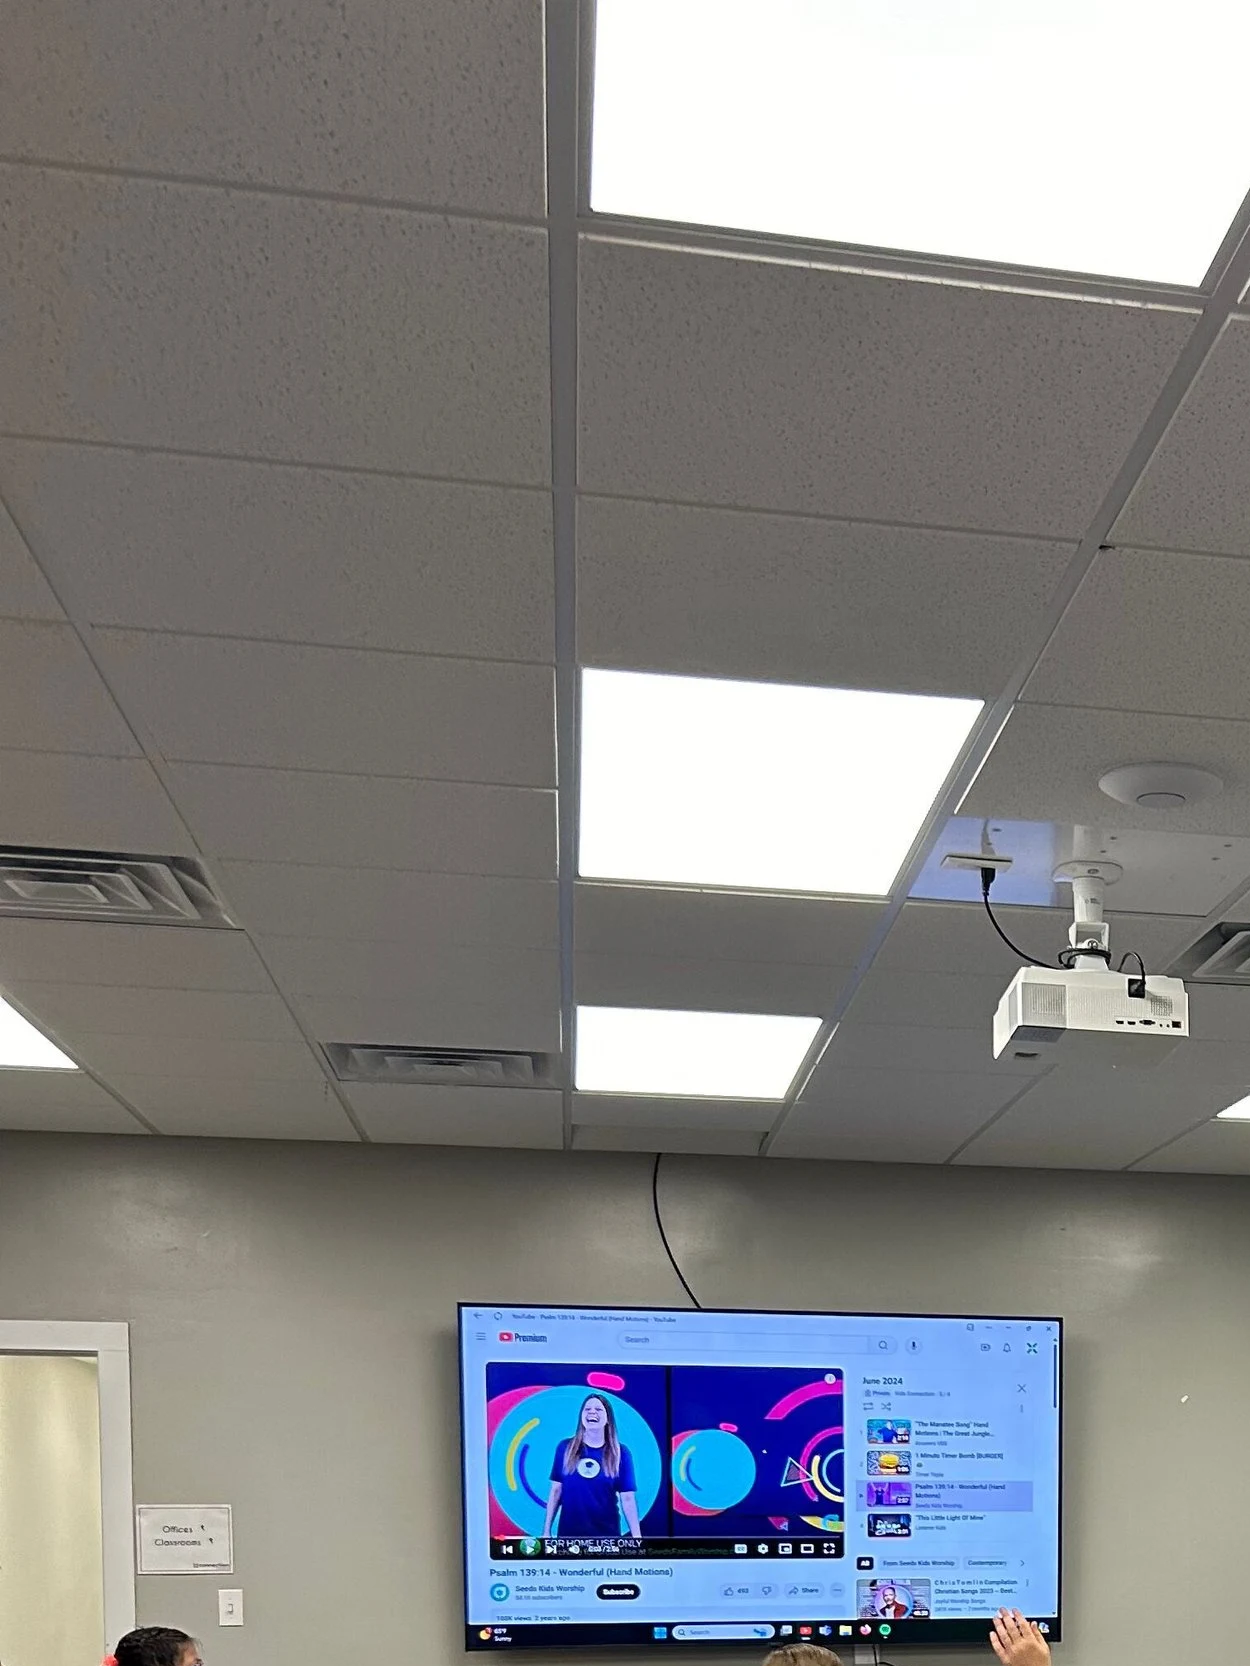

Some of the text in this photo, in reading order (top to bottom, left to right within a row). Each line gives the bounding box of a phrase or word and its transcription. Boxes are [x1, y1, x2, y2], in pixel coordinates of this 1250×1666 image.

[514, 1333, 547, 1343] Premium
[863, 1377, 903, 1385] June 2024
[162, 1525, 194, 1534] Offices
[154, 1538, 202, 1547] Classrooms
[544, 1539, 565, 1547] FOR
[566, 1539, 594, 1547] HOME
[617, 1539, 643, 1548] ONLY
[490, 1568, 518, 1577] Psalm
[519, 1568, 551, 1577] 139:14
[559, 1568, 604, 1577] Wonderful
[606, 1568, 633, 1578] (Hand
[635, 1567, 674, 1577] Motions)
[515, 1585, 585, 1594] Seeds Kids Worship
[602, 1588, 635, 1596] Subscribe
